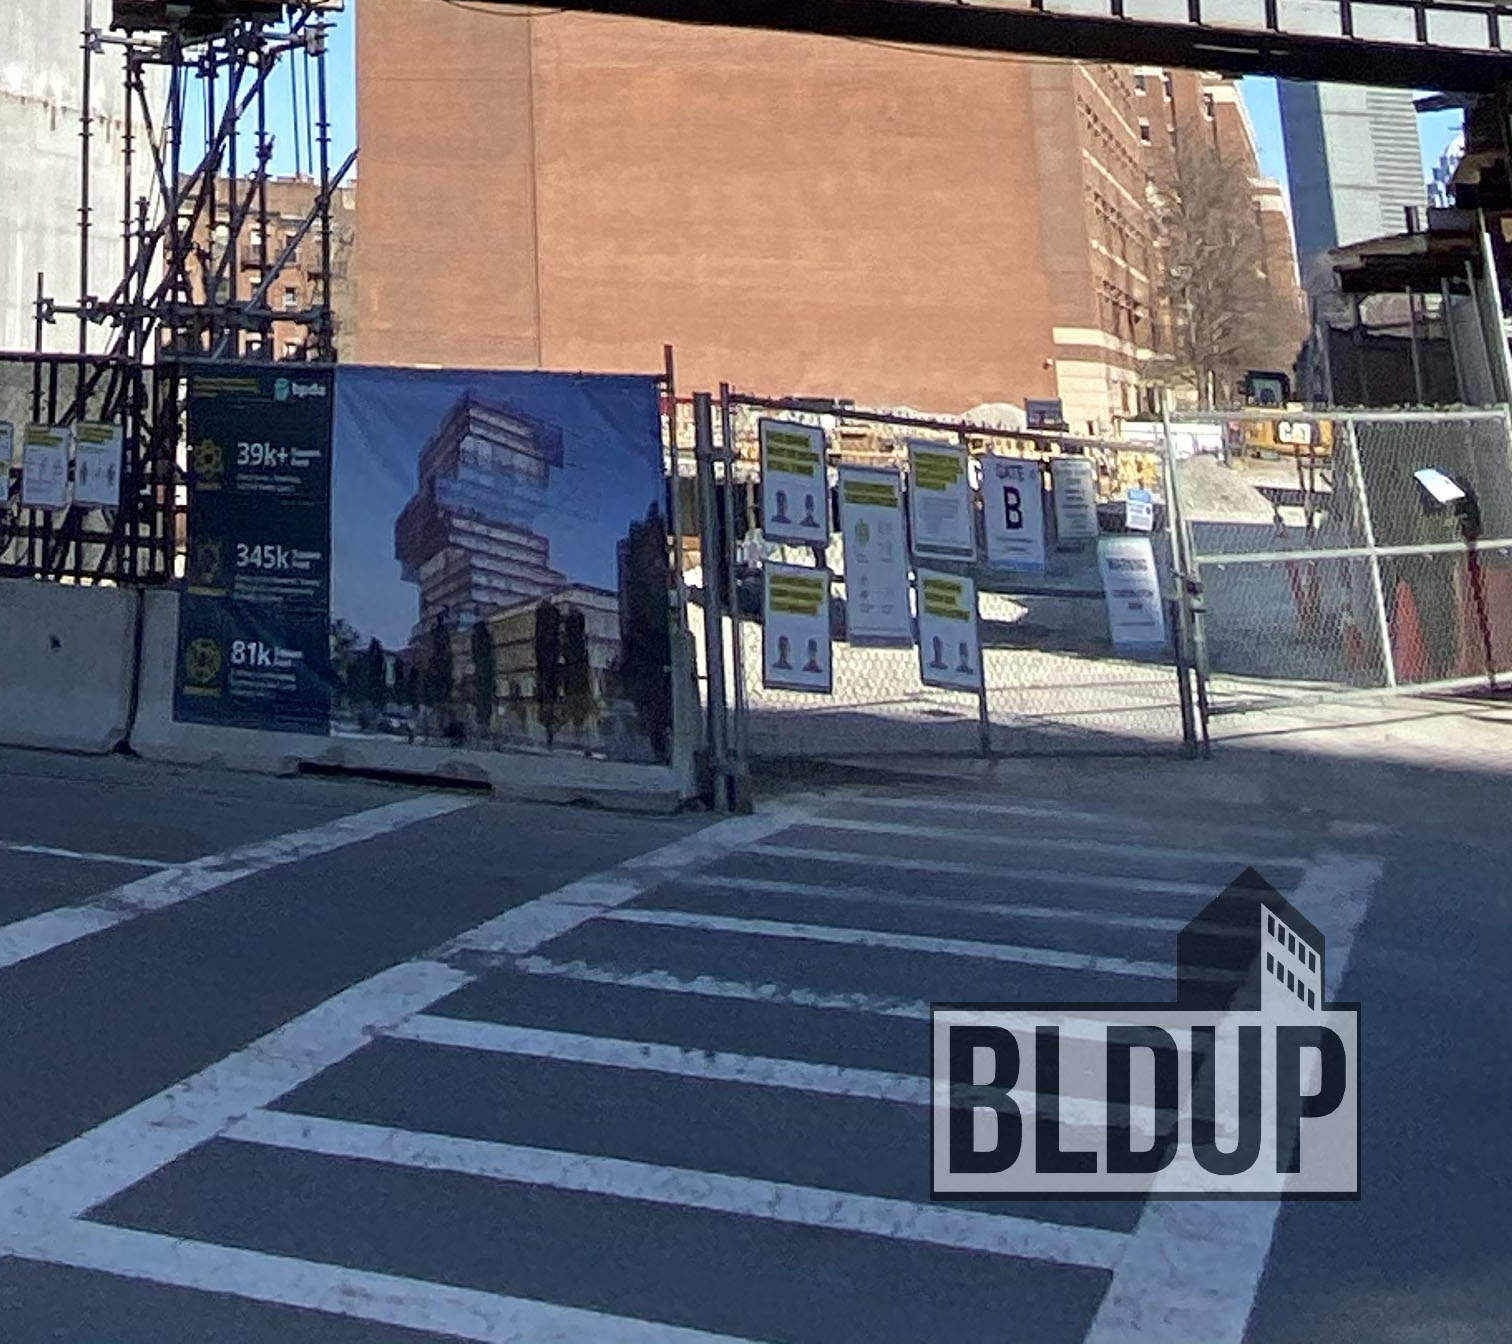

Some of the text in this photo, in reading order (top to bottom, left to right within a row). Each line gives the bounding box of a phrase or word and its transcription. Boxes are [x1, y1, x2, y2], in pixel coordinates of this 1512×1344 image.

[237, 441, 289, 468] 39k+
[1003, 485, 1024, 531] B
[236, 542, 289, 570] 345k
[229, 642, 272, 667] 81k
